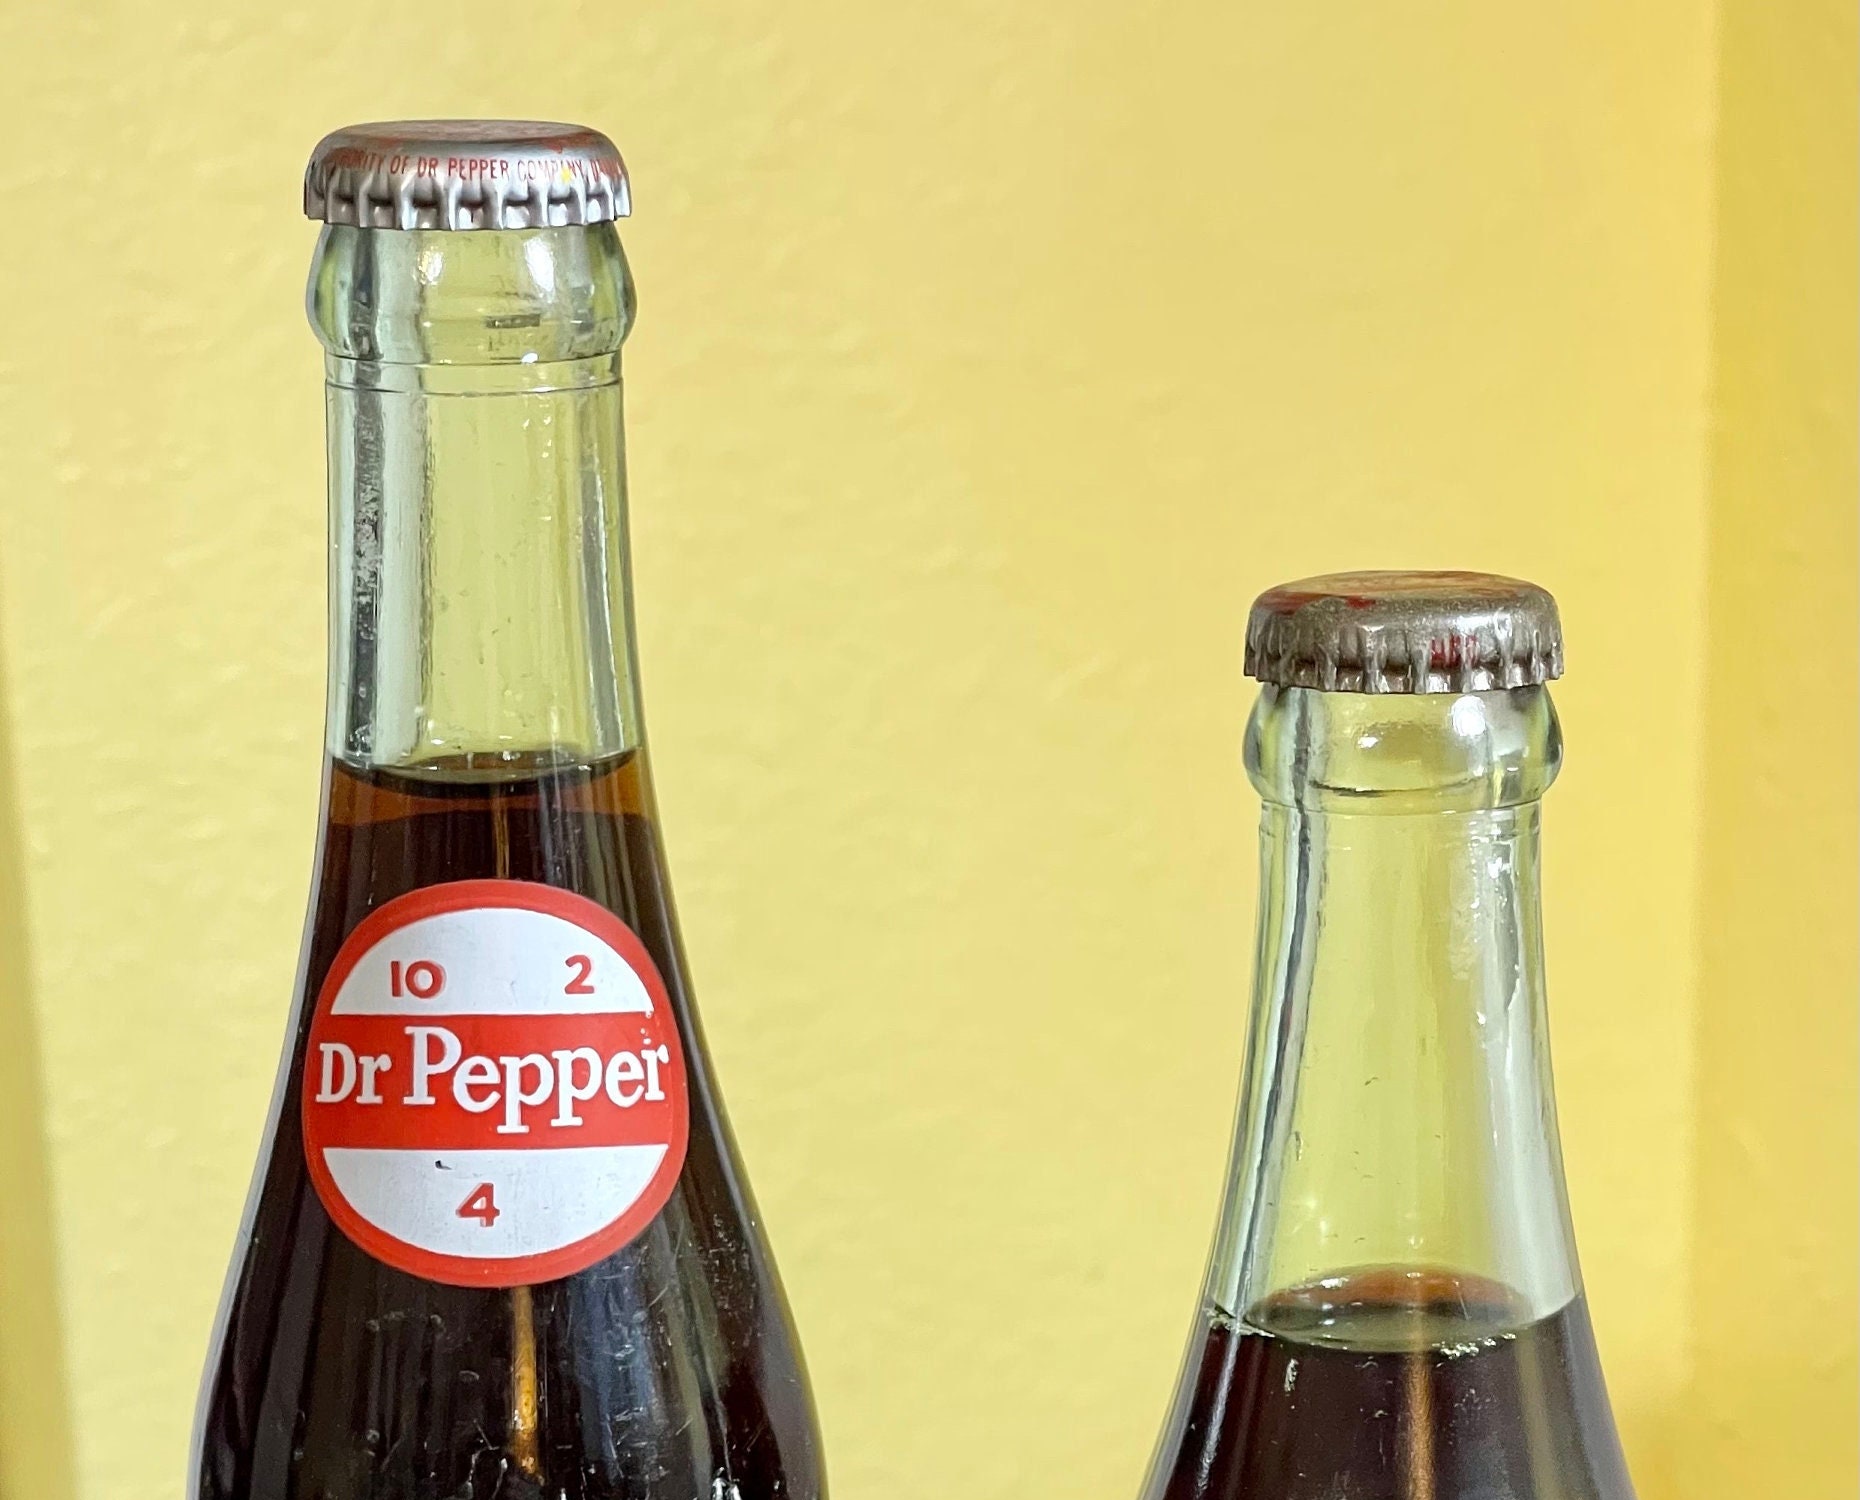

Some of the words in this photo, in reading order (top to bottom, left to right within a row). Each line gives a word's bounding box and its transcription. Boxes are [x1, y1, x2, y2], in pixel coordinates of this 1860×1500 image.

[390, 154, 410, 175] OF
[417, 157, 438, 178] DR
[449, 156, 509, 182] PEPPER
[390, 959, 447, 1000] 10
[564, 954, 596, 995] 2
[315, 1042, 392, 1105] Dr
[403, 1025, 669, 1134] Pepper
[456, 1182, 501, 1227] 4
